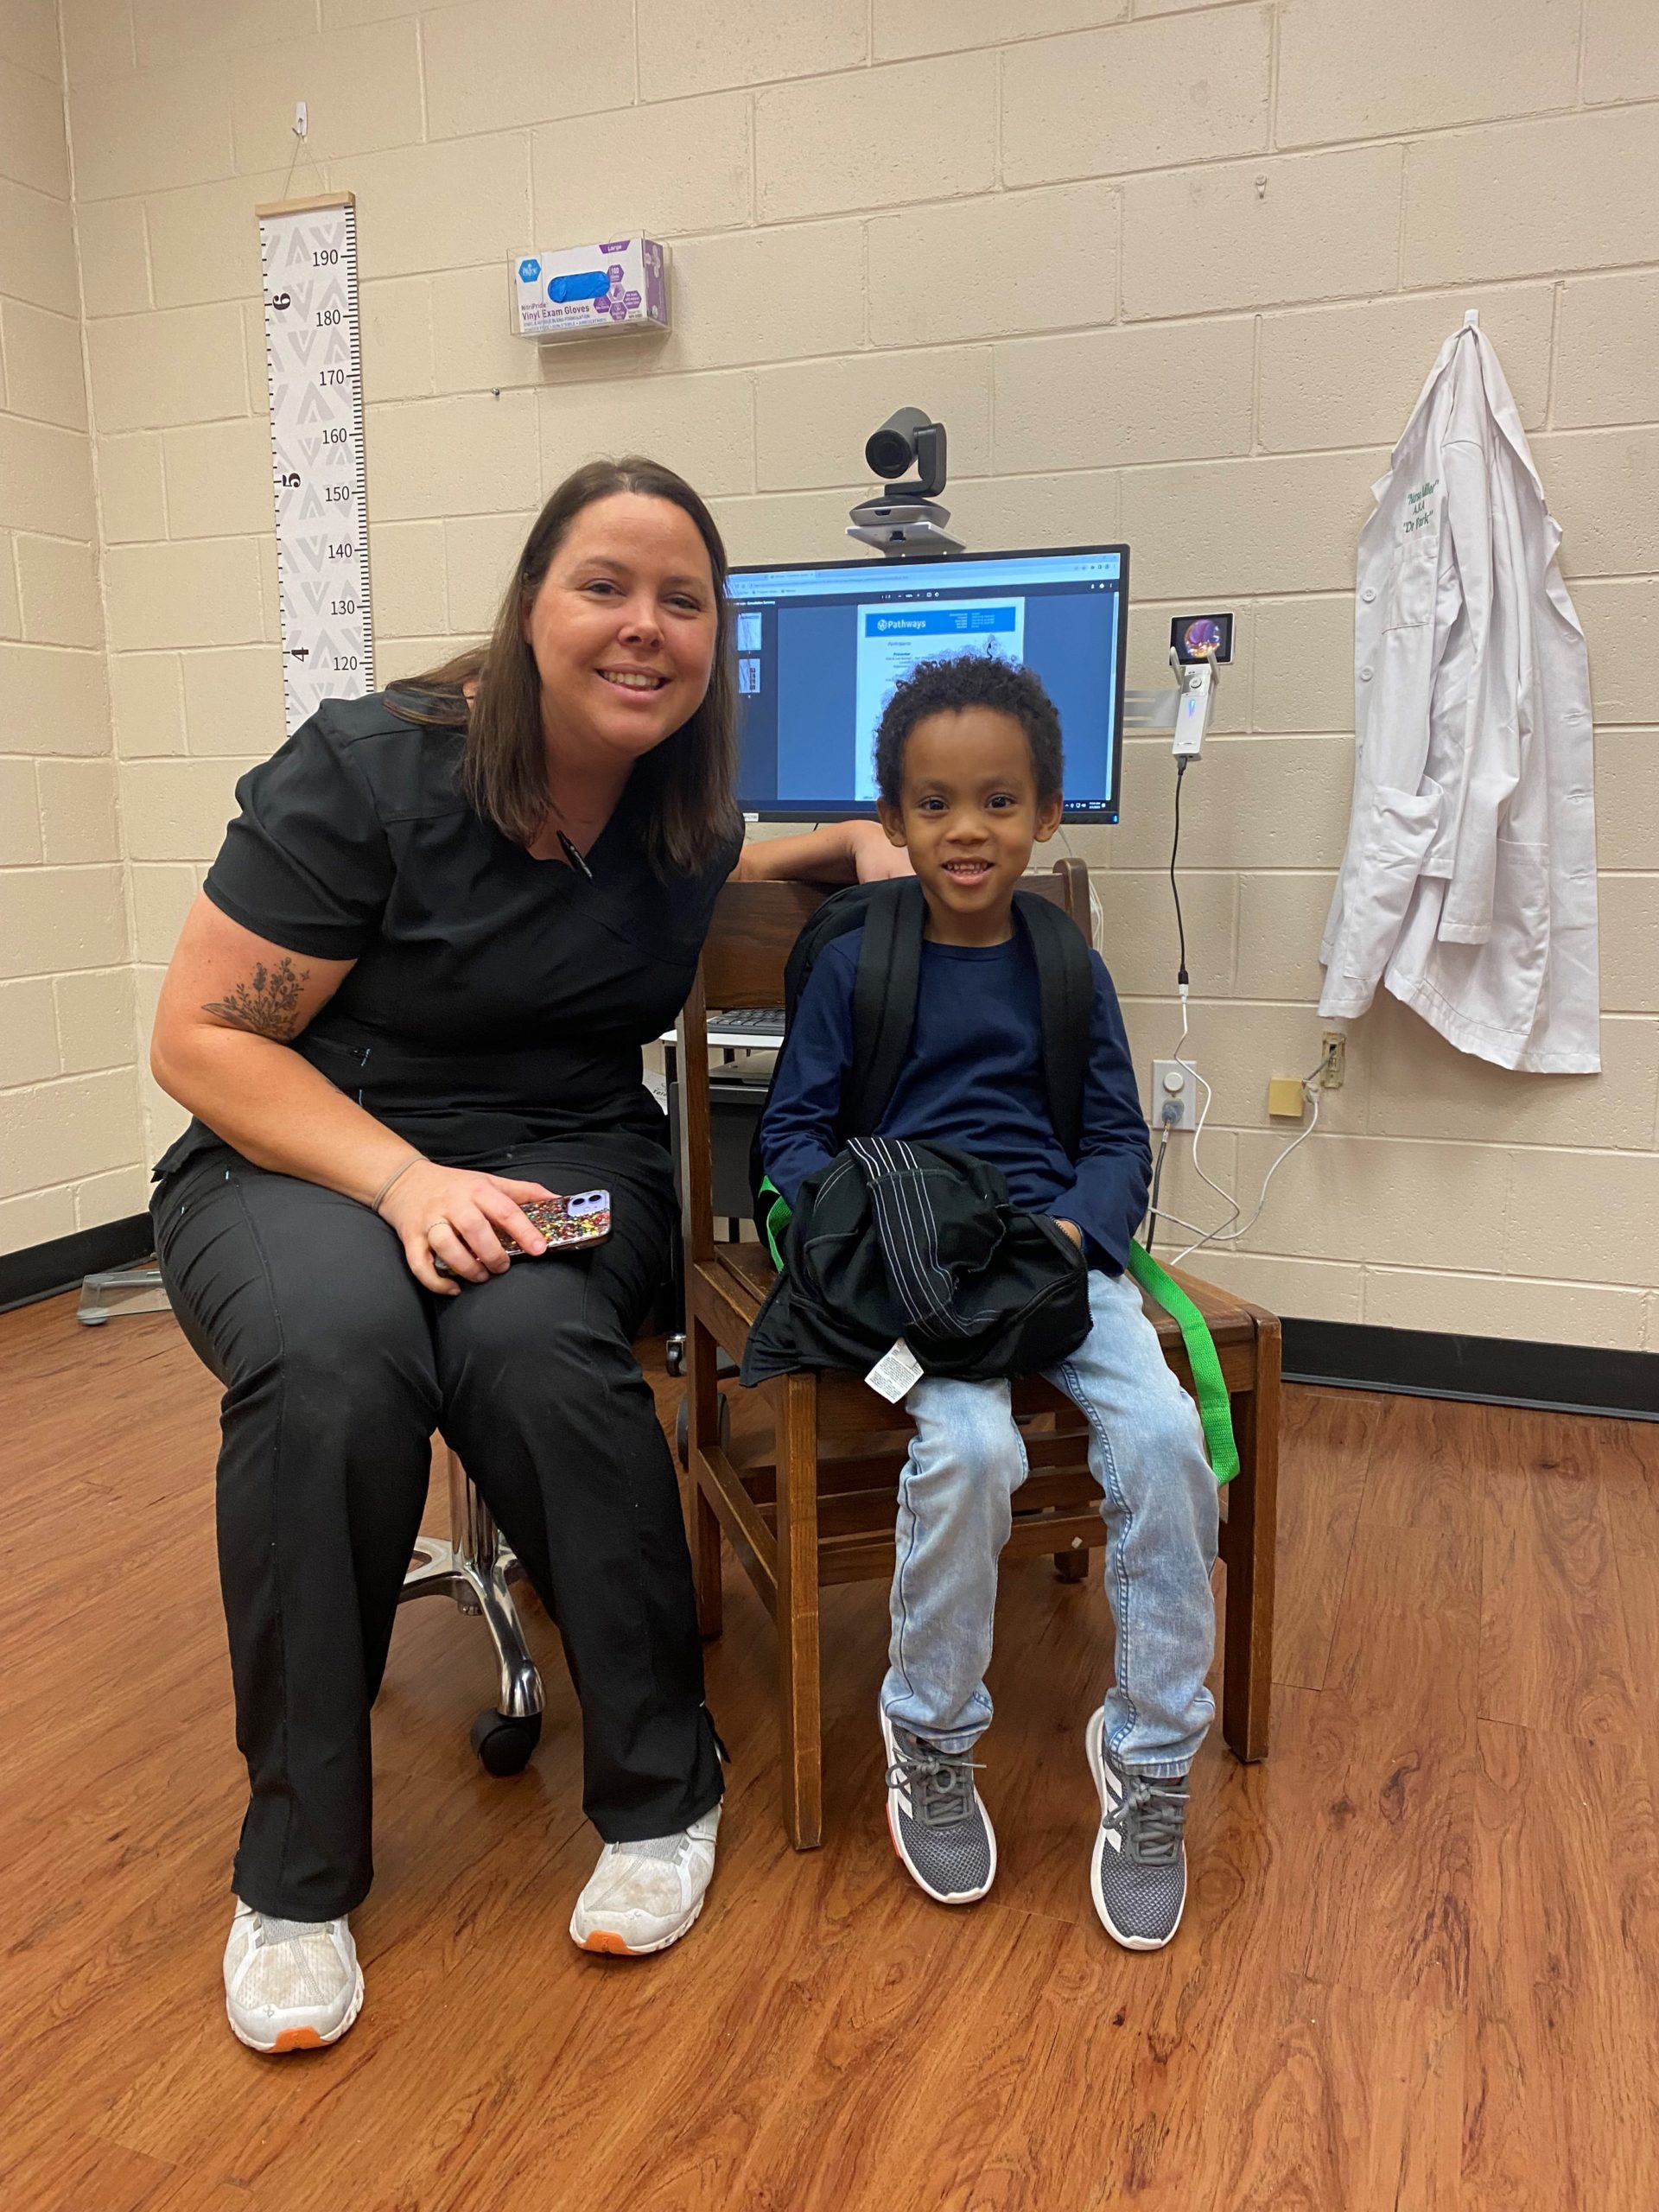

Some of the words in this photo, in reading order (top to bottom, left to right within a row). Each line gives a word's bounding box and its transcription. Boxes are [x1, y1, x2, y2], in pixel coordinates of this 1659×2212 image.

[312, 249, 339, 267] 190
[272, 292, 291, 311] 6
[315, 308, 340, 327] 180
[522, 311, 540, 321] Vinyl
[542, 309, 563, 318] Exam
[564, 305, 590, 315] Gloves
[319, 369, 345, 386] 170
[322, 428, 346, 444] 160
[282, 472, 301, 487] 5
[325, 486, 350, 502] 150
[327, 543, 353, 559] 140
[330, 600, 355, 616] 130
[887, 619, 926, 629] Pathways
[291, 646, 309, 662] 4
[333, 656, 358, 671] 120
